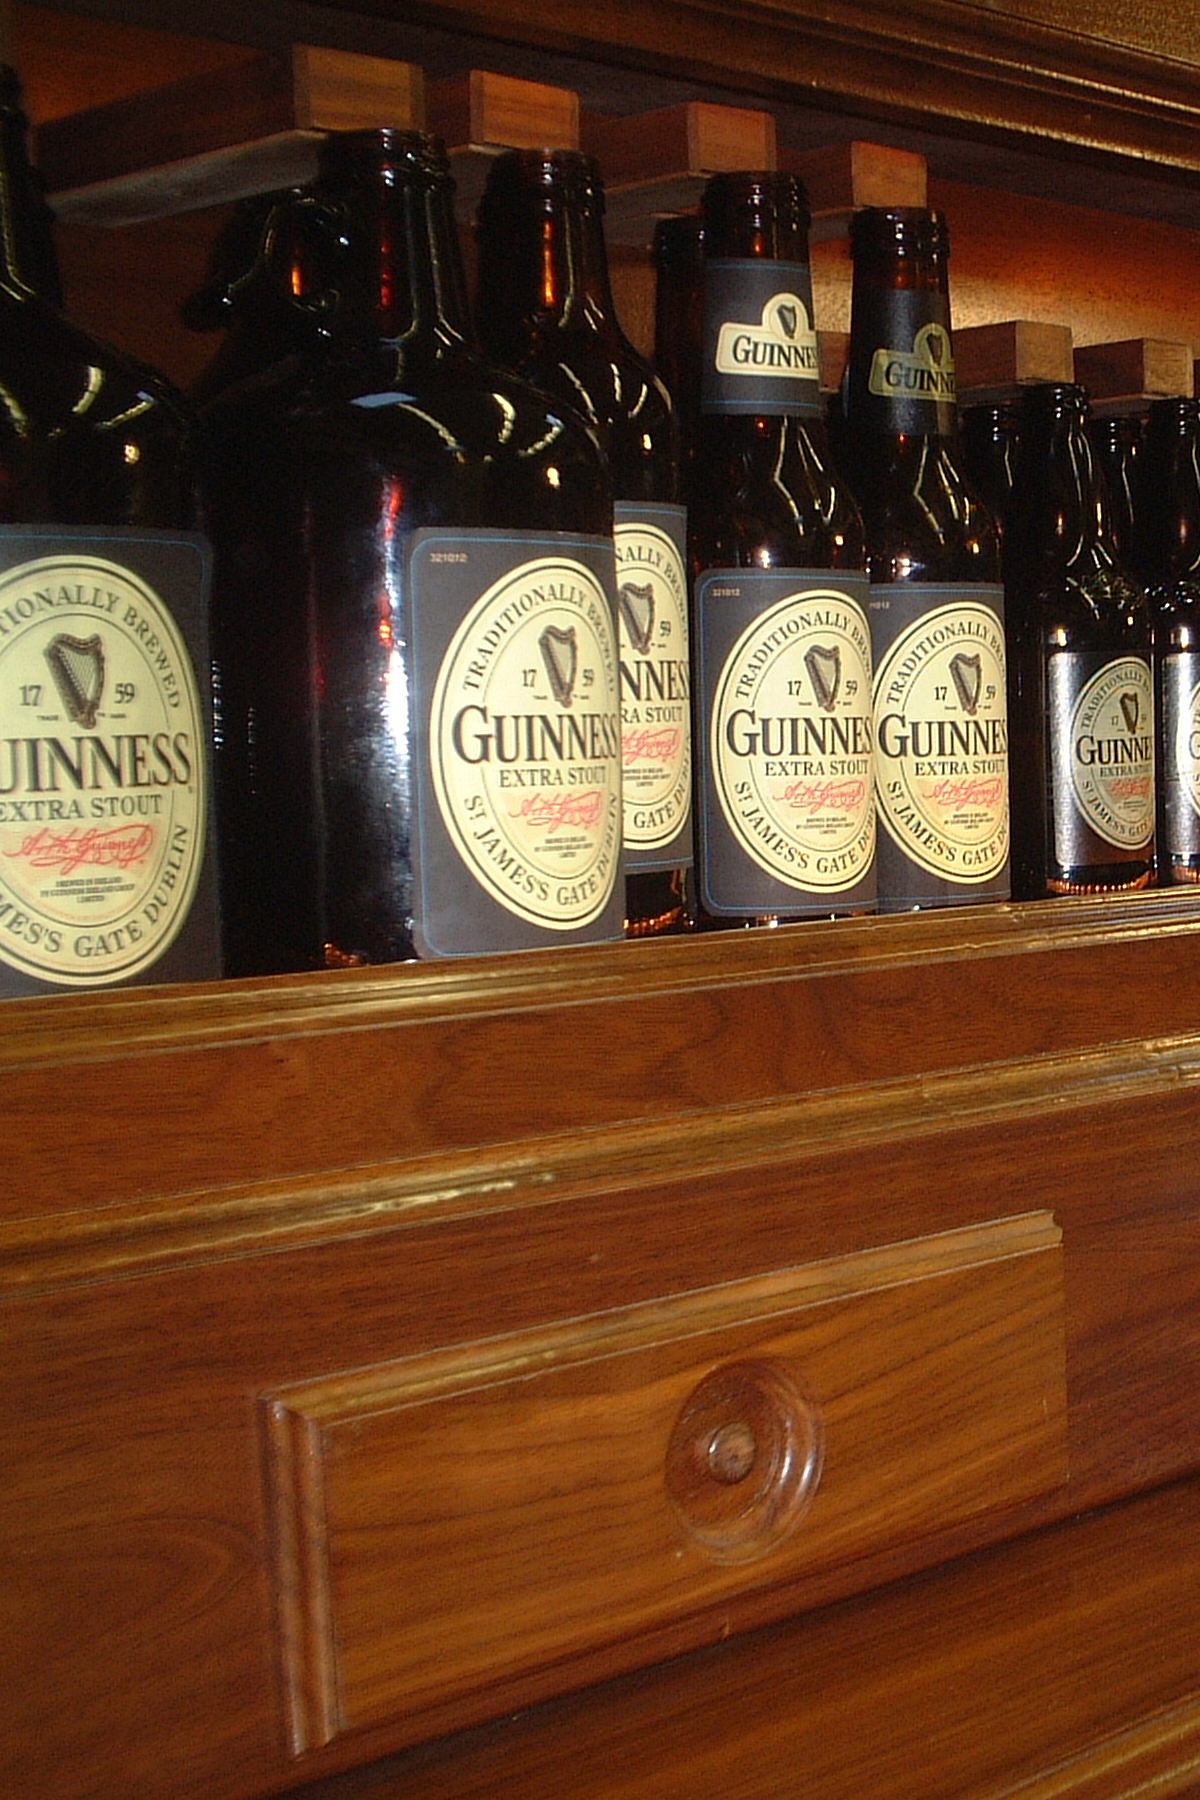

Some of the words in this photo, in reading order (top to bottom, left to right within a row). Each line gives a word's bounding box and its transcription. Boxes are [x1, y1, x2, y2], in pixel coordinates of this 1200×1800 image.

[463, 582, 587, 692] TRADITIONALLY
[123, 604, 181, 709] BREWED
[736, 610, 850, 699] TRADITIONALLY
[886, 621, 990, 705] TRADITIONALLY
[522, 668, 538, 689] 17
[787, 680, 802, 696] 17
[19, 684, 42, 707] 17
[113, 682, 136, 704] 59
[934, 686, 948, 701] 17
[645, 705, 684, 723] STOUT
[451, 704, 618, 765] GUINNESS
[499, 768, 564, 788] EXTRA
[568, 765, 607, 785] STOUT
[764, 761, 826, 777] EXTRA
[829, 759, 869, 775] STOUT
[915, 761, 969, 776] EXTRA
[972, 759, 1006, 775] STOUT
[91, 794, 163, 818] STOUT
[633, 801, 676, 829] GATE
[741, 807, 811, 870] JAMES'S
[816, 850, 860, 874] GATE
[893, 805, 958, 863] JAMES'S
[961, 842, 998, 866] GATE
[473, 827, 550, 902] JAMES'S
[556, 873, 599, 906] GATE
[74, 919, 144, 958] GATE
[142, 824, 189, 924] DUBLIN
